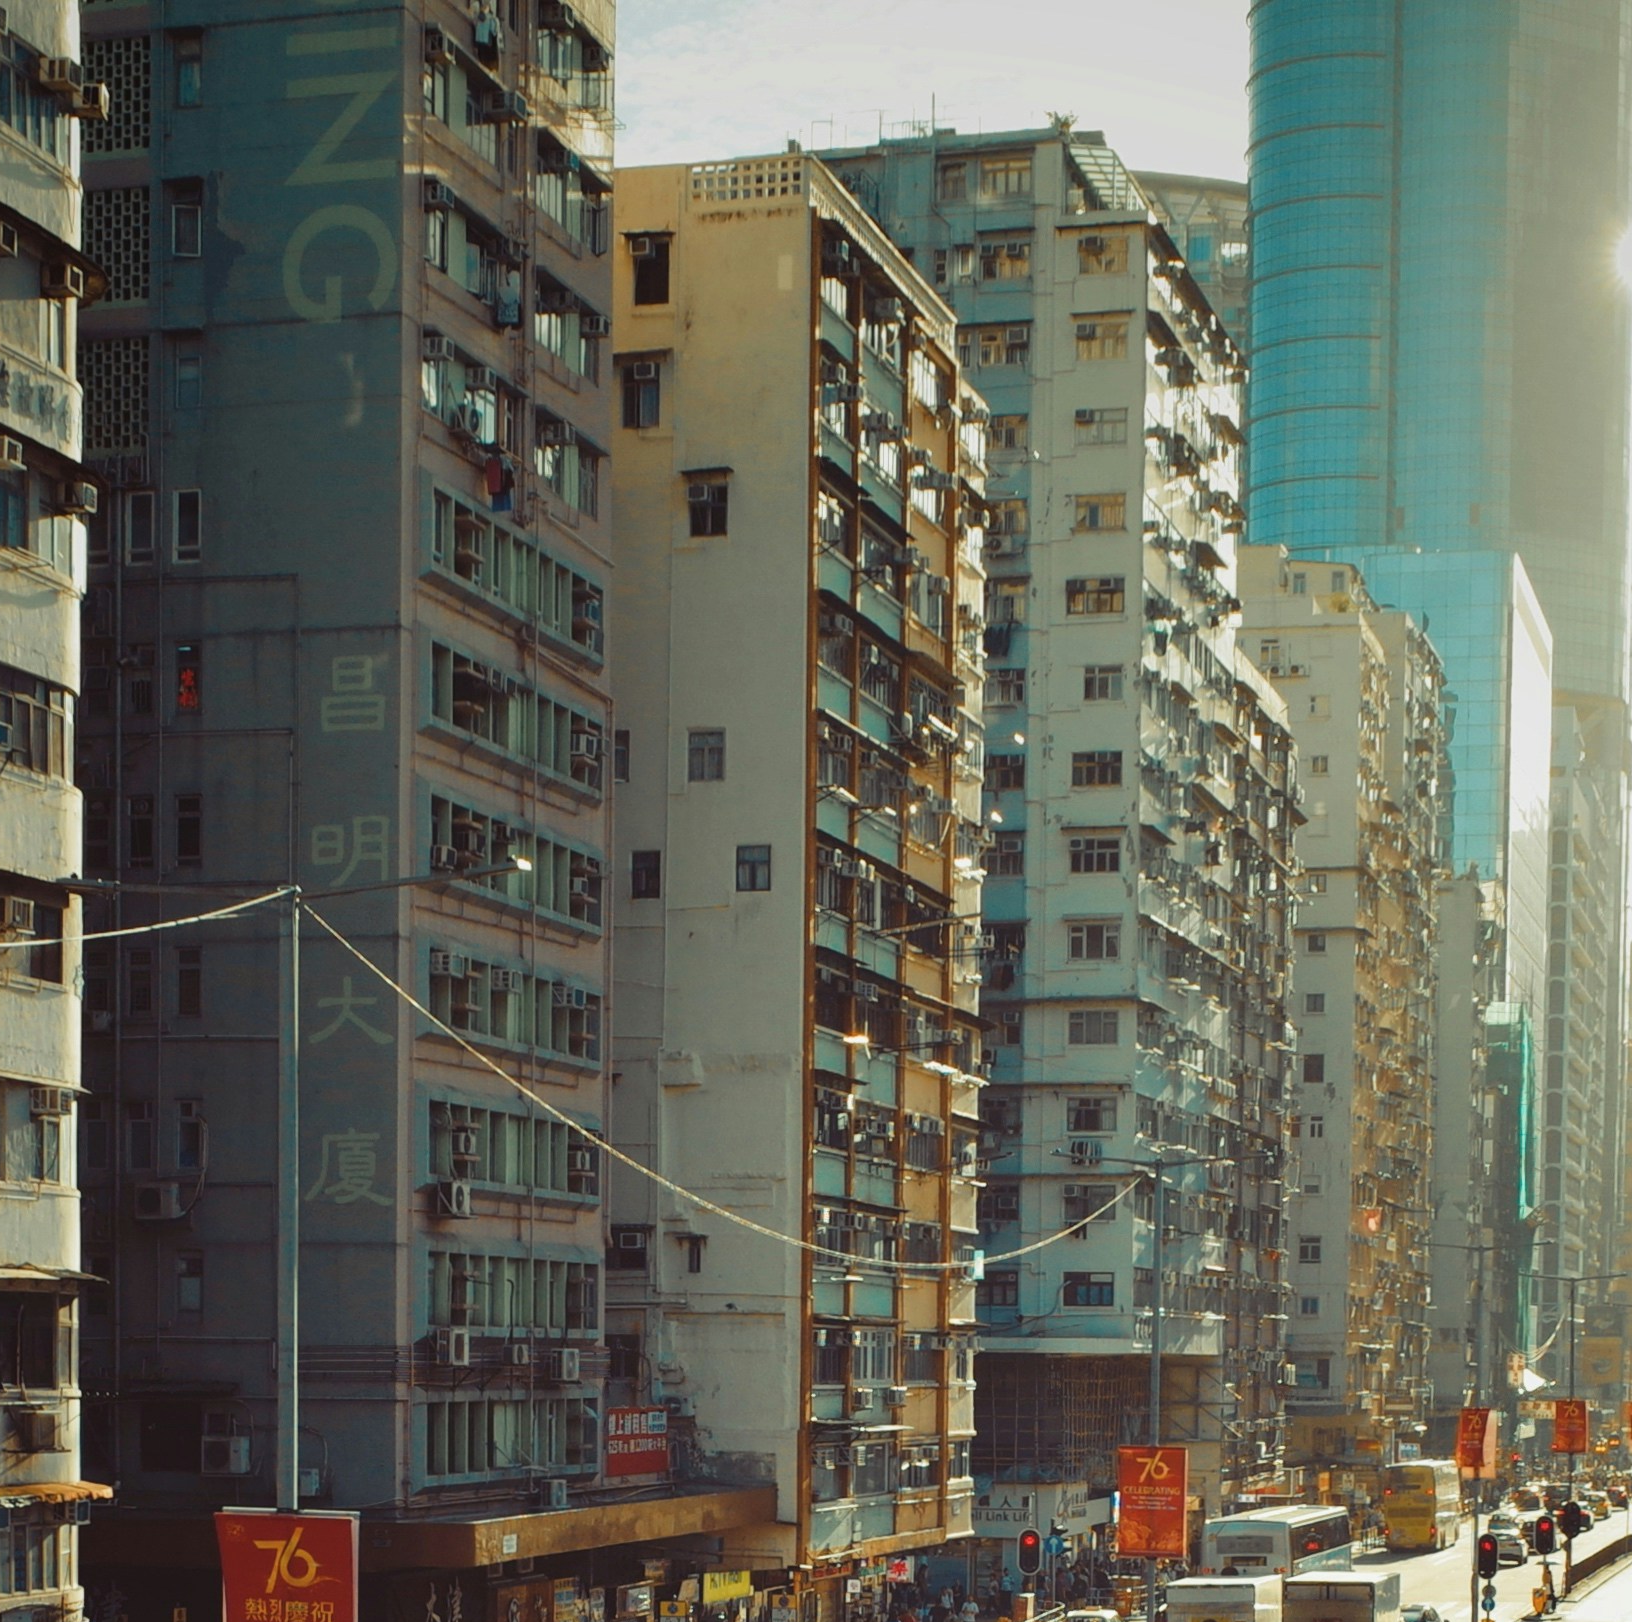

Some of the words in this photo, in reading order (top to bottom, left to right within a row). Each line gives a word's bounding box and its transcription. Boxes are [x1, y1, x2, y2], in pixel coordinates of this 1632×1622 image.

[304, 652, 396, 1208] 昌明大廈
[1136, 1450, 1171, 1483] 76
[252, 1526, 320, 1594] 76
